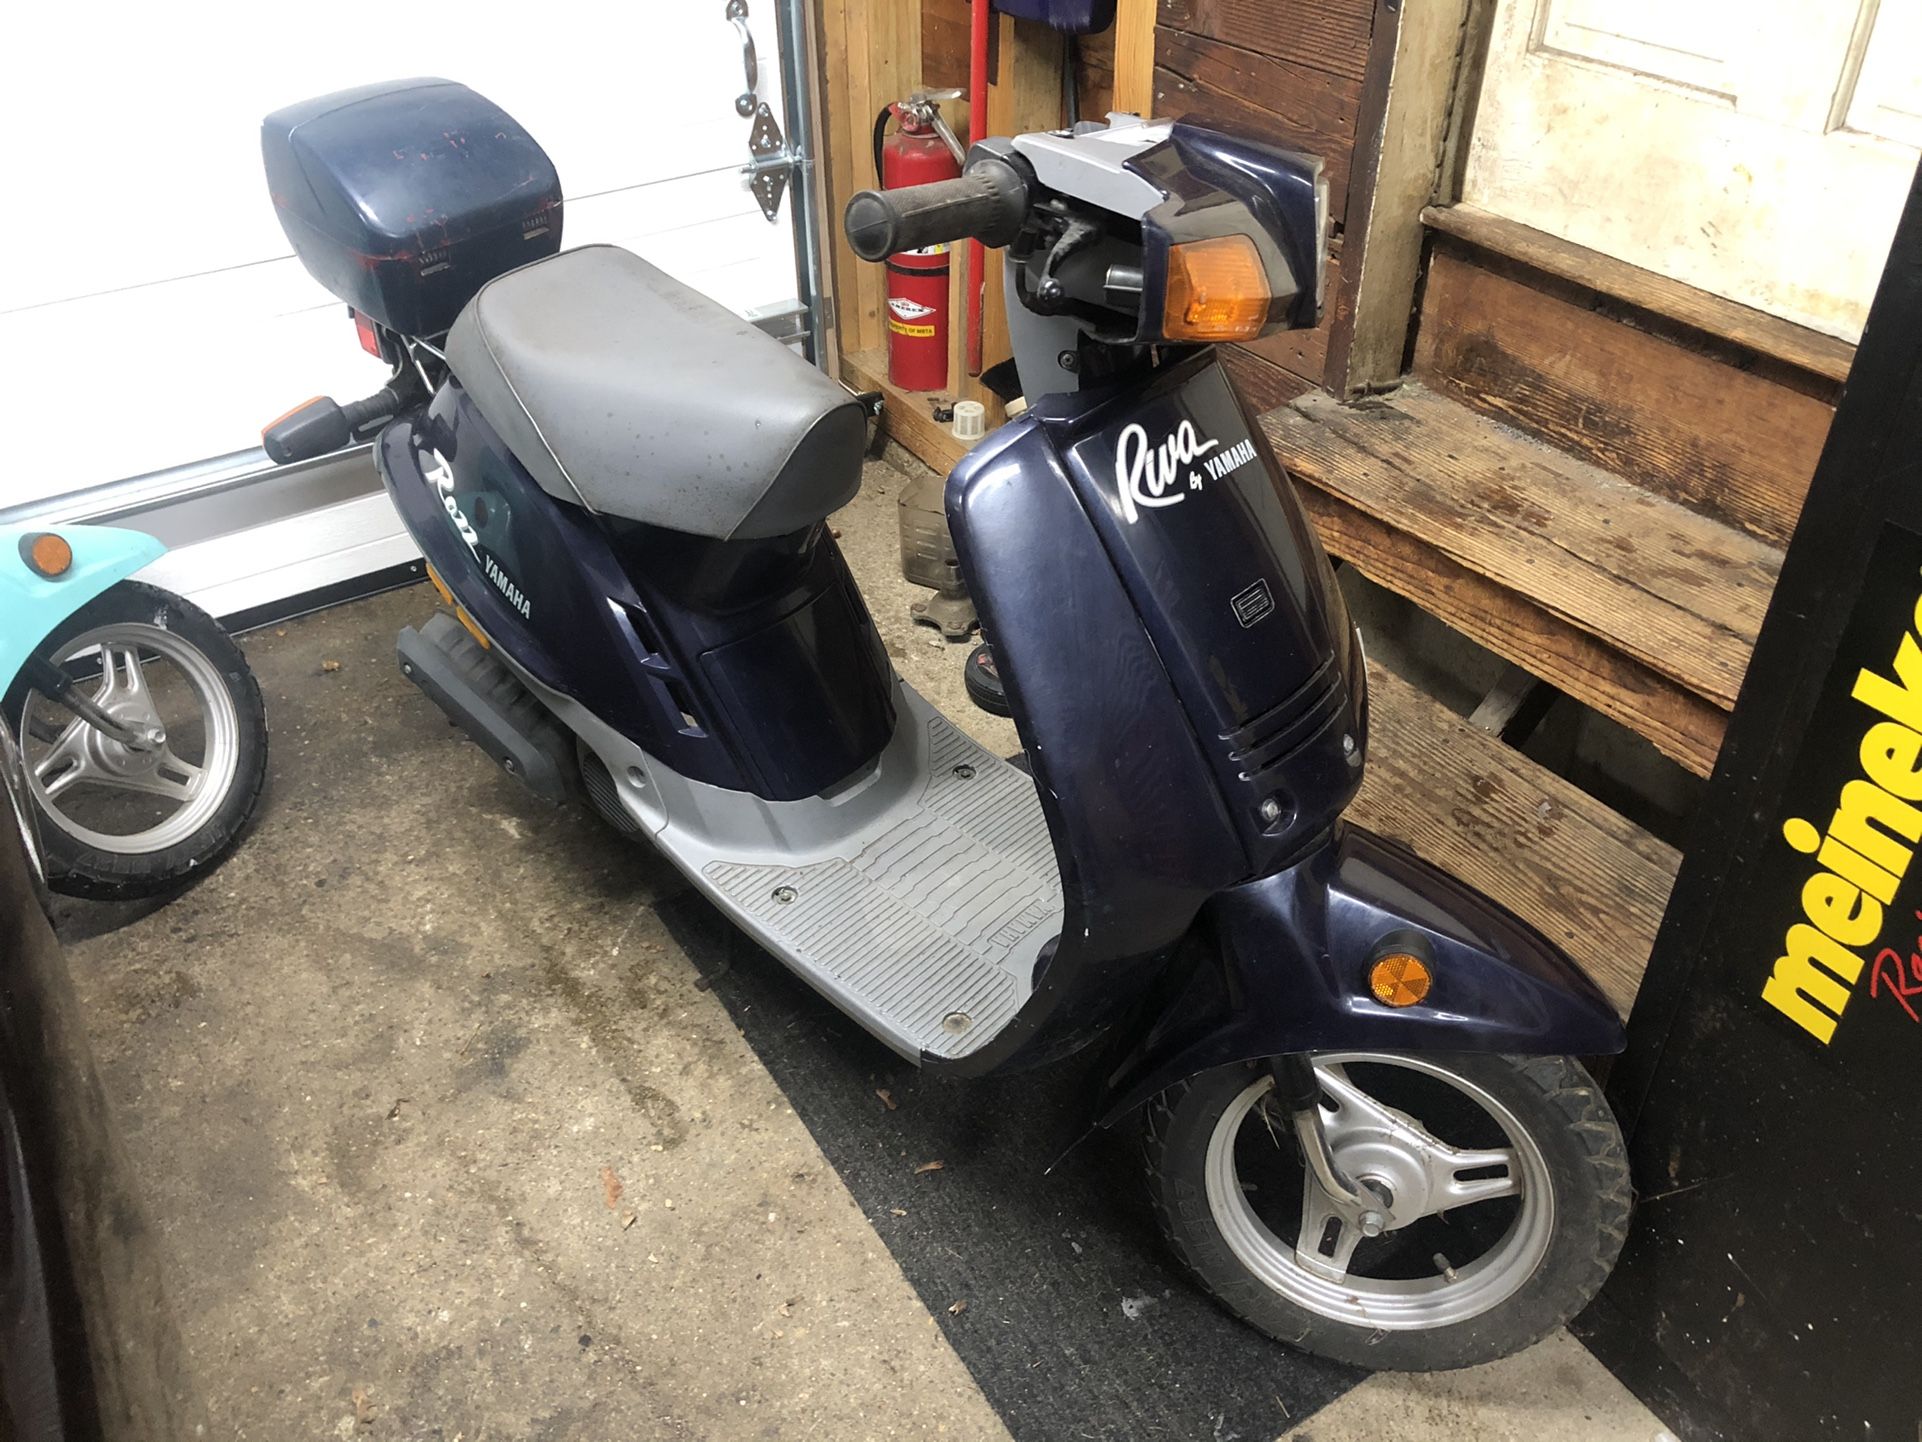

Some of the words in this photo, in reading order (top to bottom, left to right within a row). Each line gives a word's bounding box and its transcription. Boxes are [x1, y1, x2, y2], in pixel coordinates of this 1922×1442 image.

[1115, 419, 1219, 524] Riva
[1203, 438, 1257, 481] YAMAHA
[484, 555, 532, 620] YAMAHA
[1761, 592, 1922, 1045] meinek
